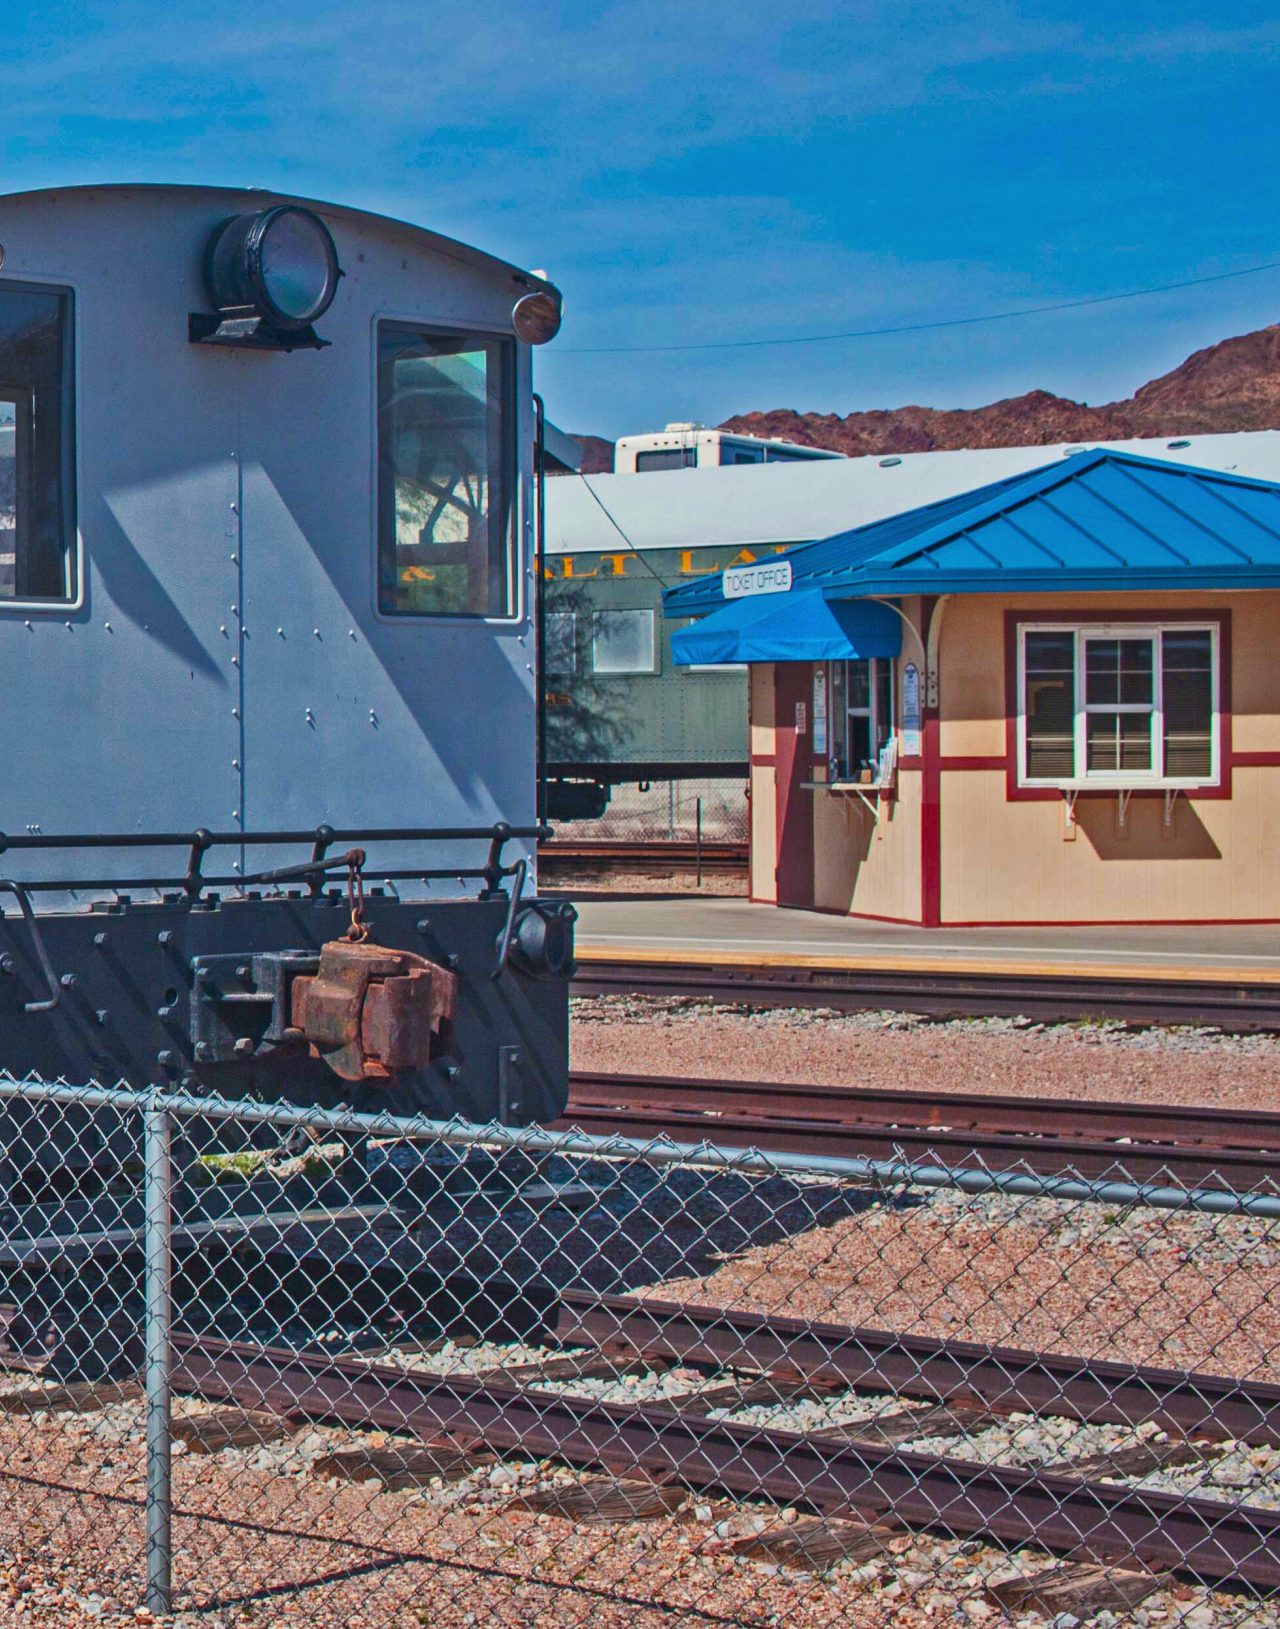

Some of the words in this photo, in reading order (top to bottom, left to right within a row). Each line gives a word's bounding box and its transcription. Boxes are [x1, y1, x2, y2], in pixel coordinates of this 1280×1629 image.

[679, 546, 789, 574] LA
[726, 573, 754, 592] TICKET
[757, 568, 788, 588] OFFICE
